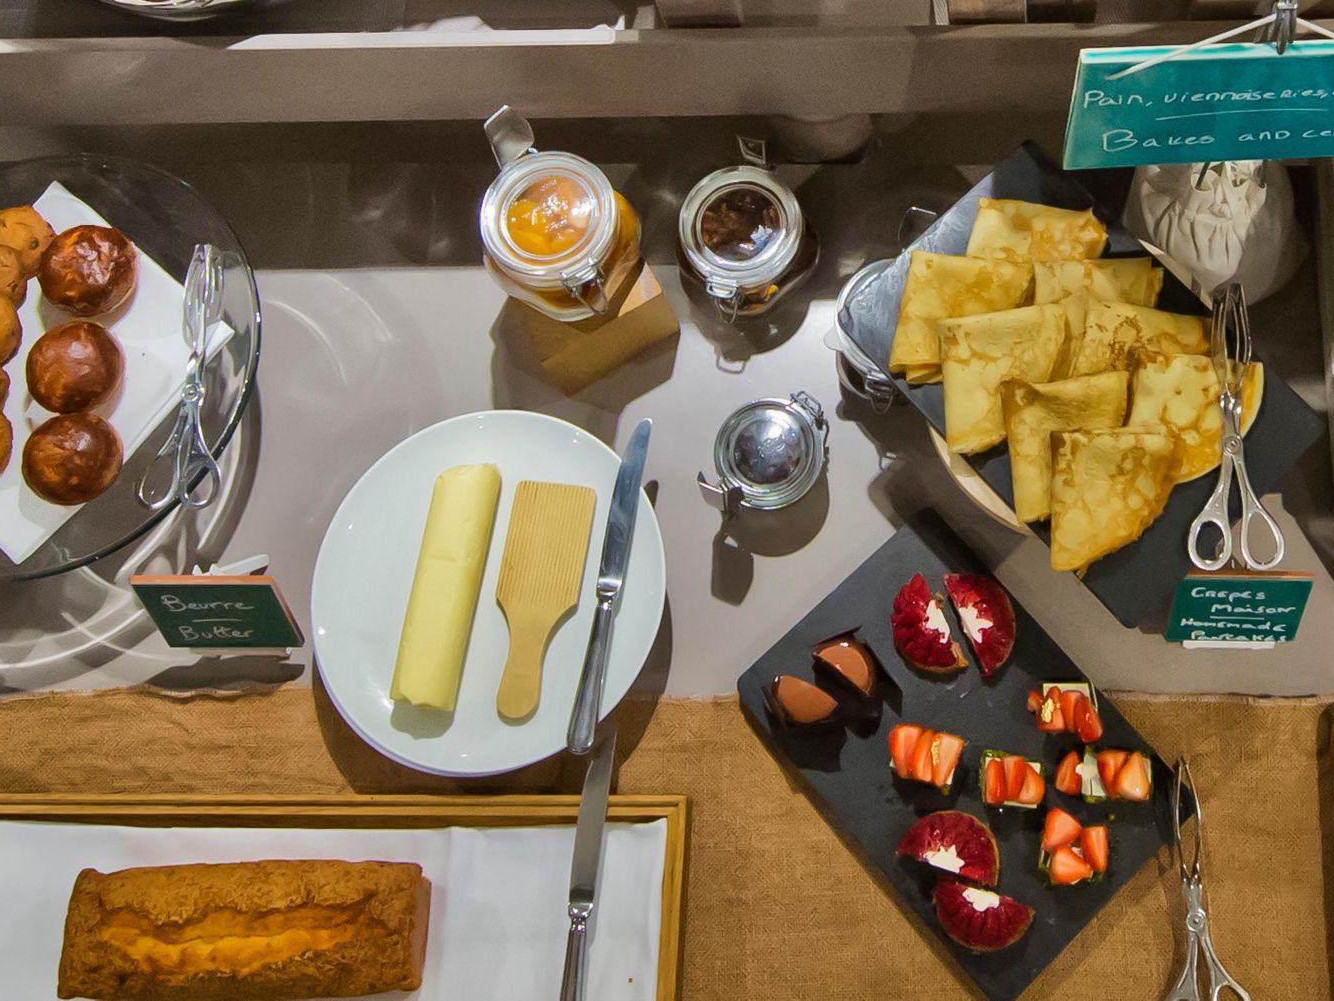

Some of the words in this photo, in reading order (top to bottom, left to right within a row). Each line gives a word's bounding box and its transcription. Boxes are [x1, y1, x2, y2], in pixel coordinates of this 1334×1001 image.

[1083, 89, 1154, 108] Pain,
[1101, 129, 1216, 152] Bakes
[160, 594, 255, 612] Beurre
[178, 625, 255, 641] Butter
